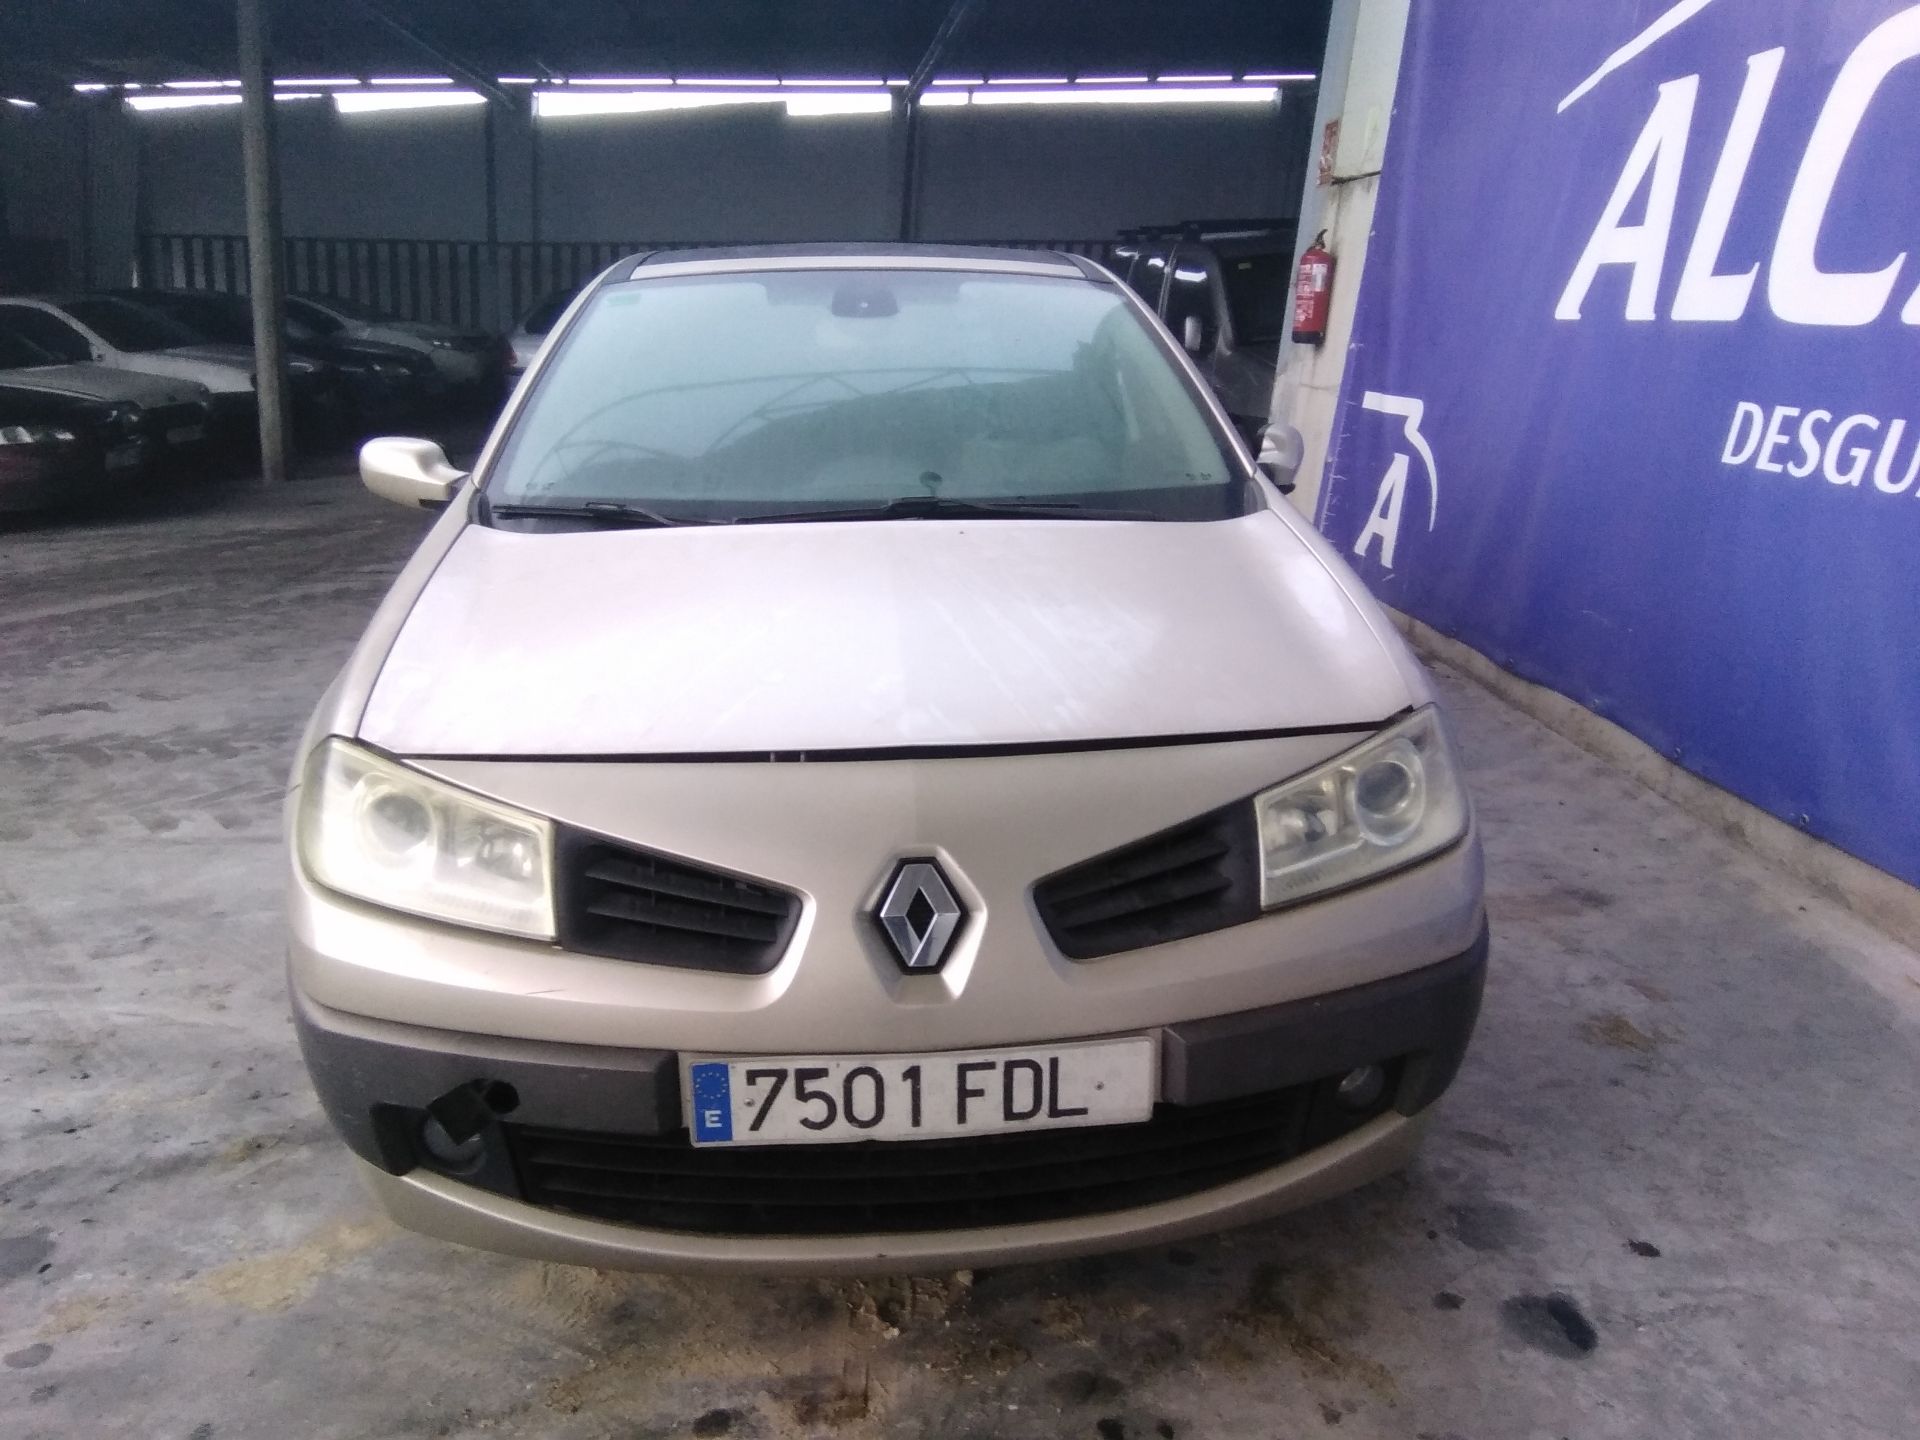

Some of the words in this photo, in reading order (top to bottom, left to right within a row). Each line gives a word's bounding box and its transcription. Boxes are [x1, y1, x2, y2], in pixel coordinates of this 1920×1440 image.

[1554, 4, 1920, 326] ALC
[1721, 401, 1920, 498] DESGU
[704, 1109, 722, 1128] E
[745, 1065, 923, 1132] 7501
[955, 1056, 1089, 1126] FDL
